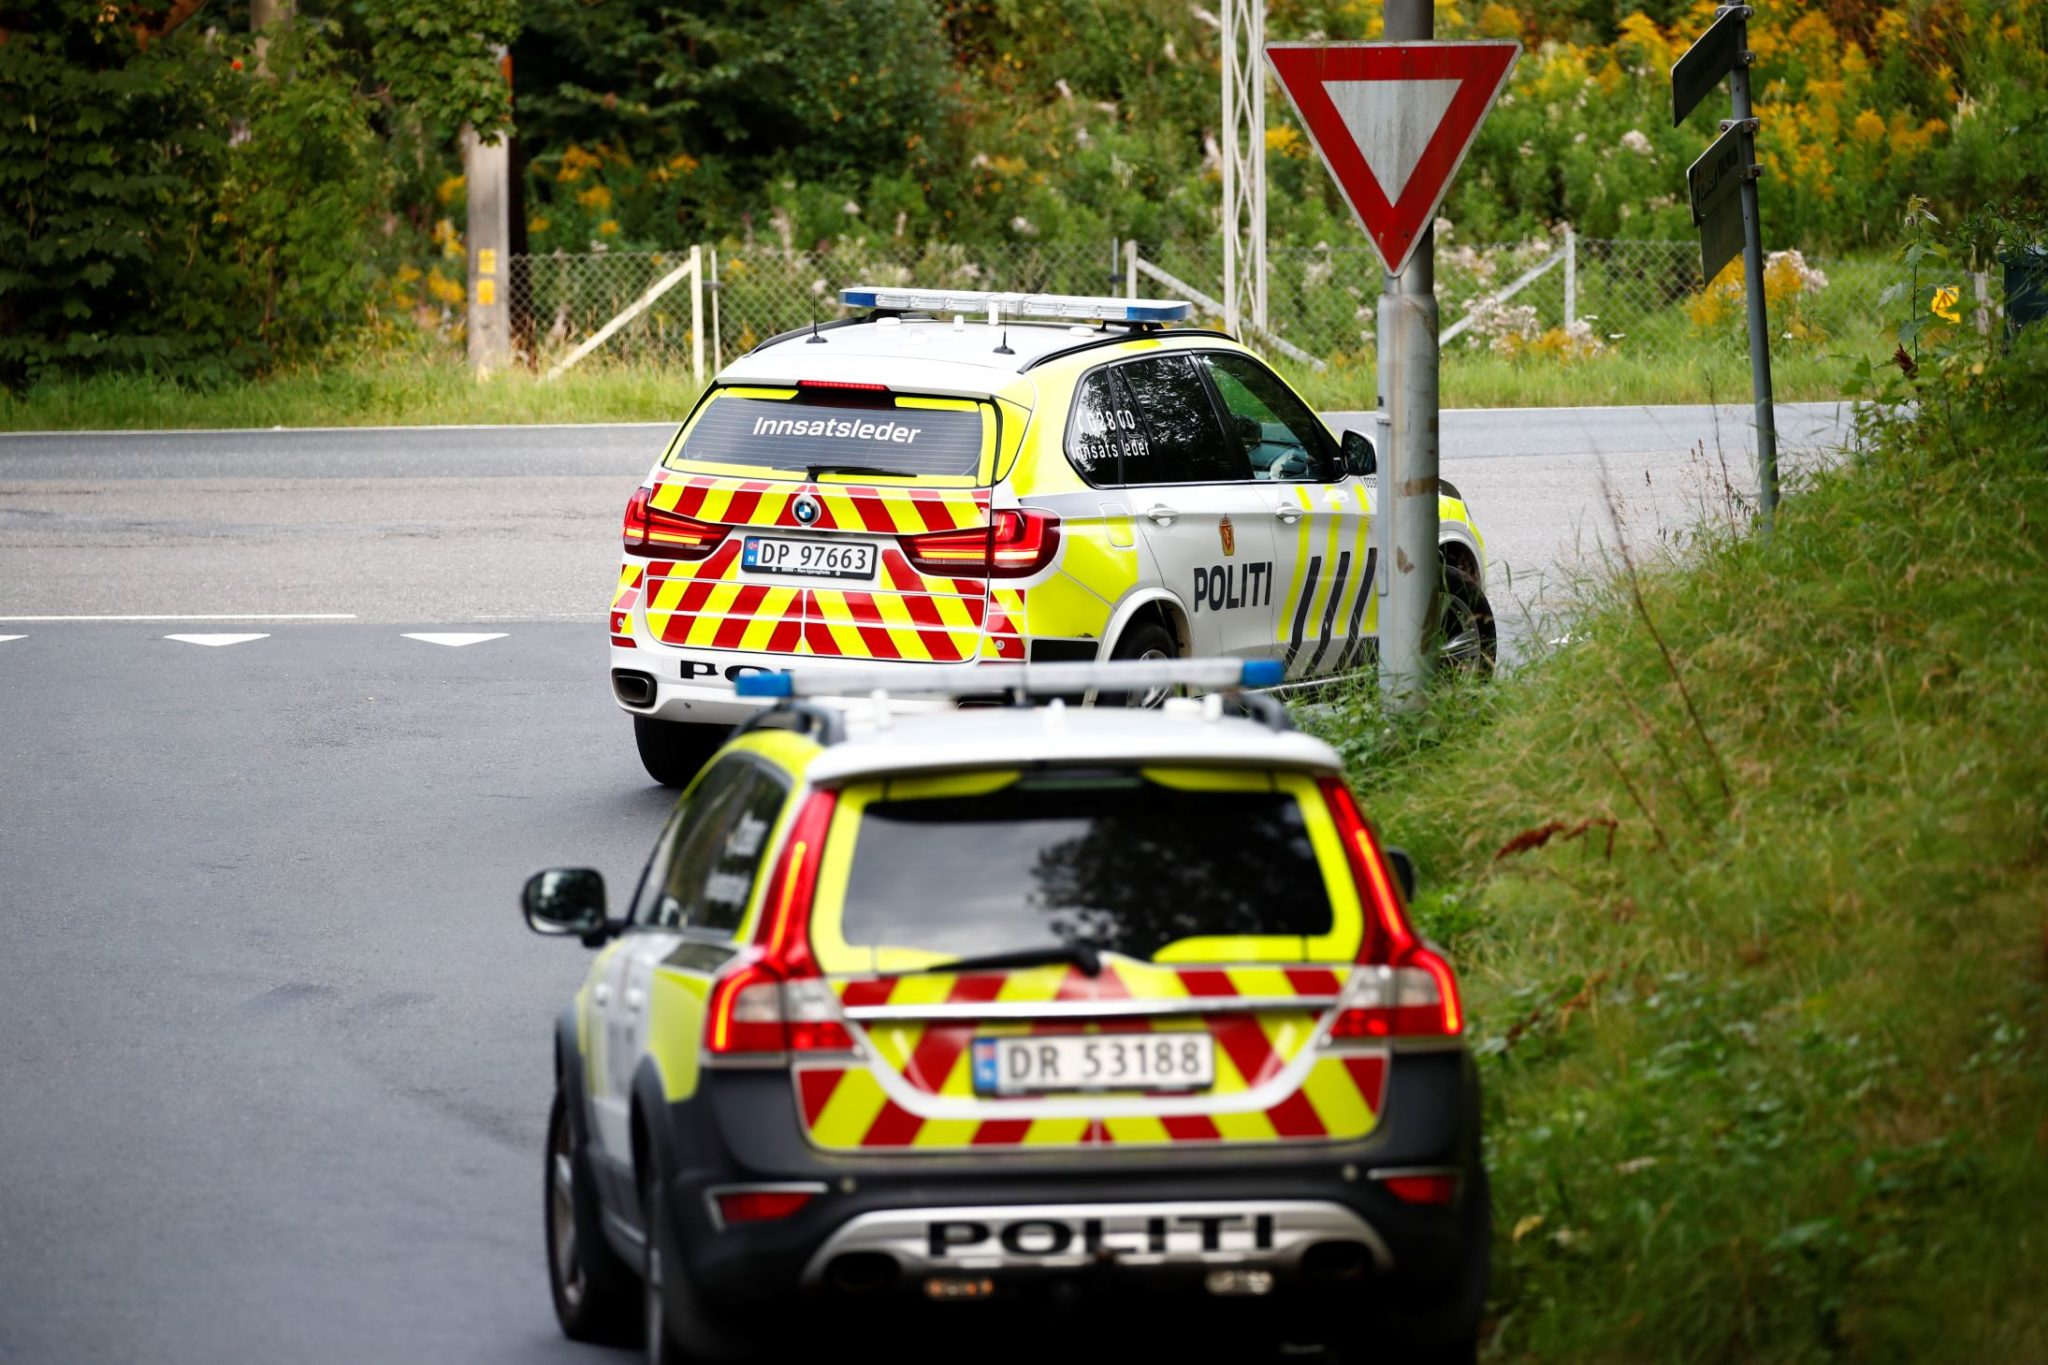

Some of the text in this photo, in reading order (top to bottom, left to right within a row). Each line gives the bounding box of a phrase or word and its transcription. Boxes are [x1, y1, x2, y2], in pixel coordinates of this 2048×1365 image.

[752, 416, 922, 444] Innsatsleder
[761, 543, 867, 570] DP 97663
[1193, 561, 1273, 613] POLITI
[1008, 1044, 1060, 1080] DR
[1084, 1041, 1200, 1078] 53188
[926, 1214, 1276, 1258] POLITI
